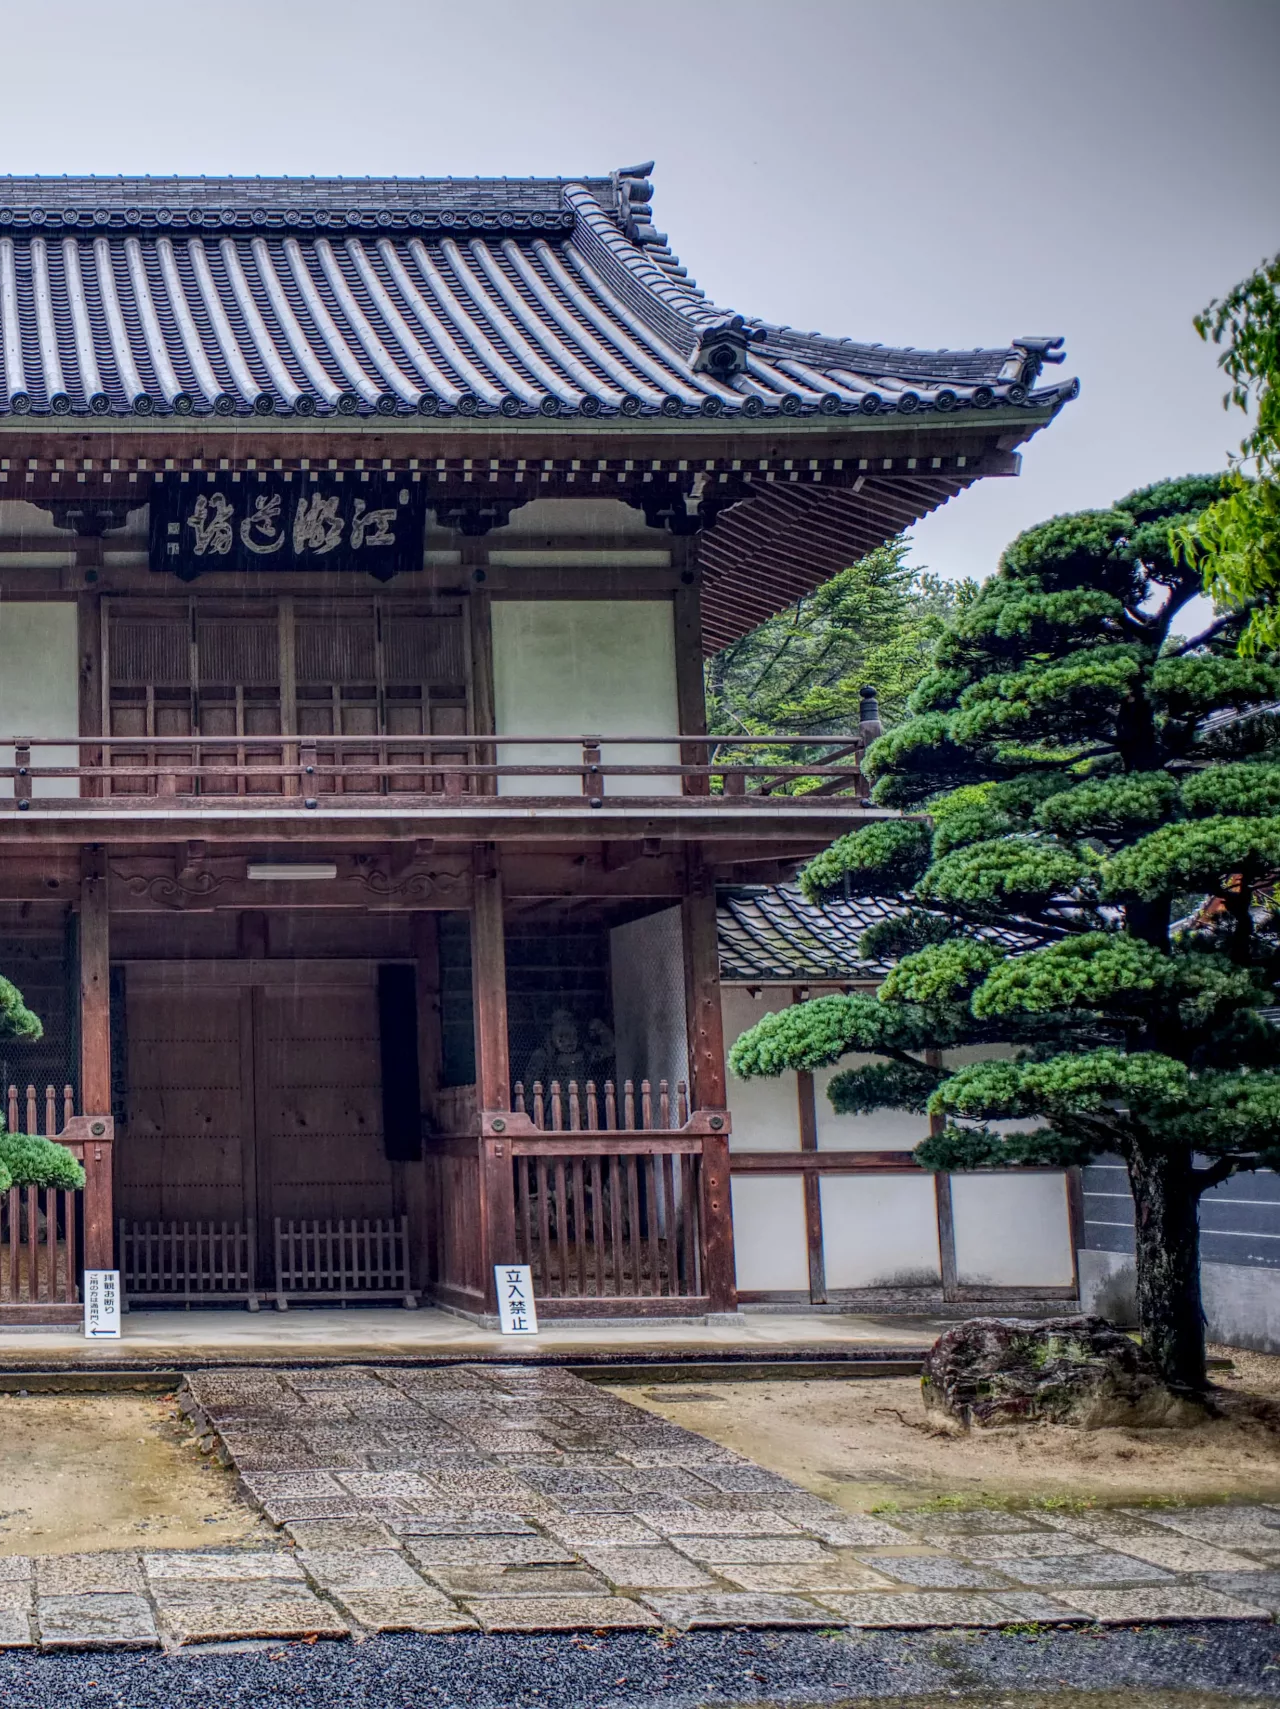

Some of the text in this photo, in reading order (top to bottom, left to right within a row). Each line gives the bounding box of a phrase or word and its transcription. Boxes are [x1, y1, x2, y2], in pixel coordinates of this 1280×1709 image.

[89, 1273, 99, 1326] ご用の方は通用門へ
[104, 1273, 114, 1314] 拝観お断り
[505, 1269, 528, 1330] 立入禁止
